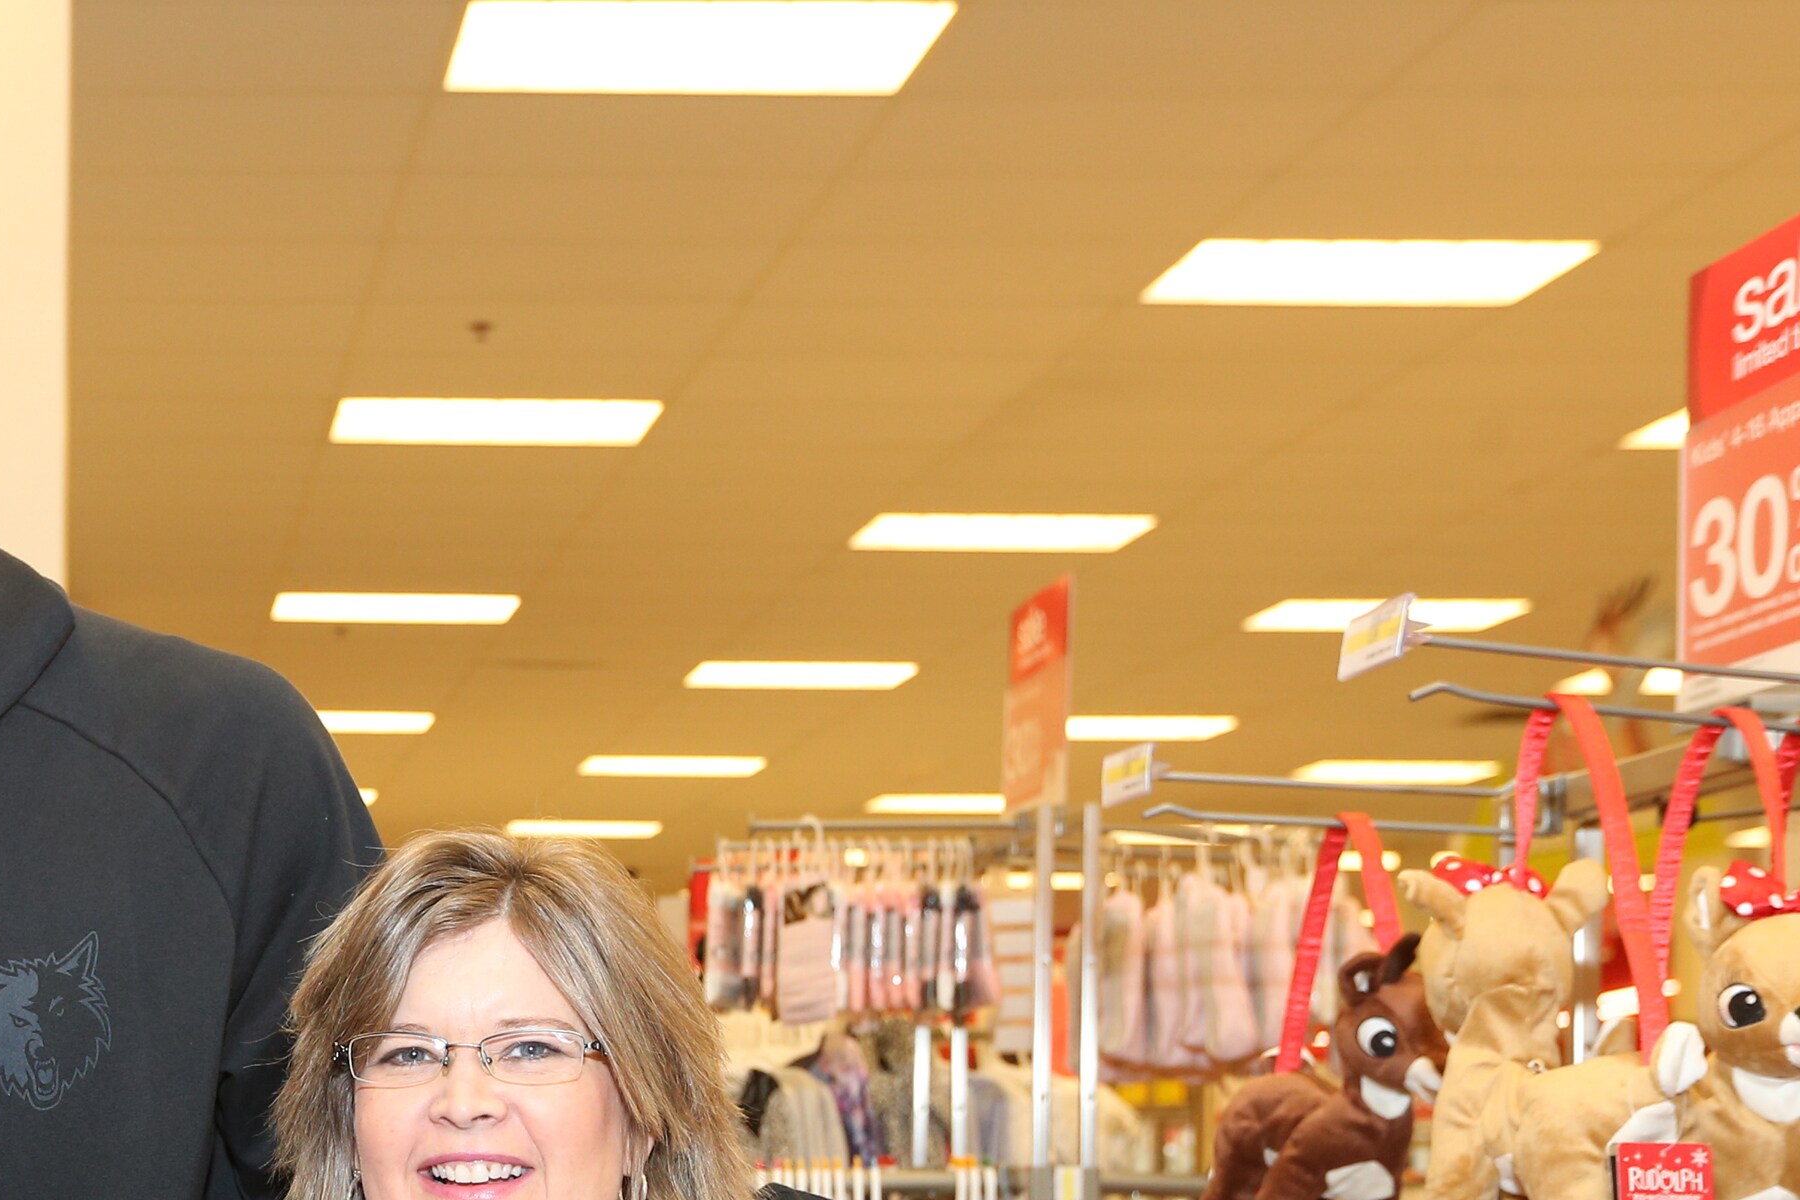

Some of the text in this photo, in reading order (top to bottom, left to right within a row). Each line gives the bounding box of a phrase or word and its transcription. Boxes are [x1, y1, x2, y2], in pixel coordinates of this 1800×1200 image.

[1731, 257, 1800, 343] sa
[1689, 473, 1789, 617] 30
[1628, 1166, 1704, 1192] RUDOLPH
